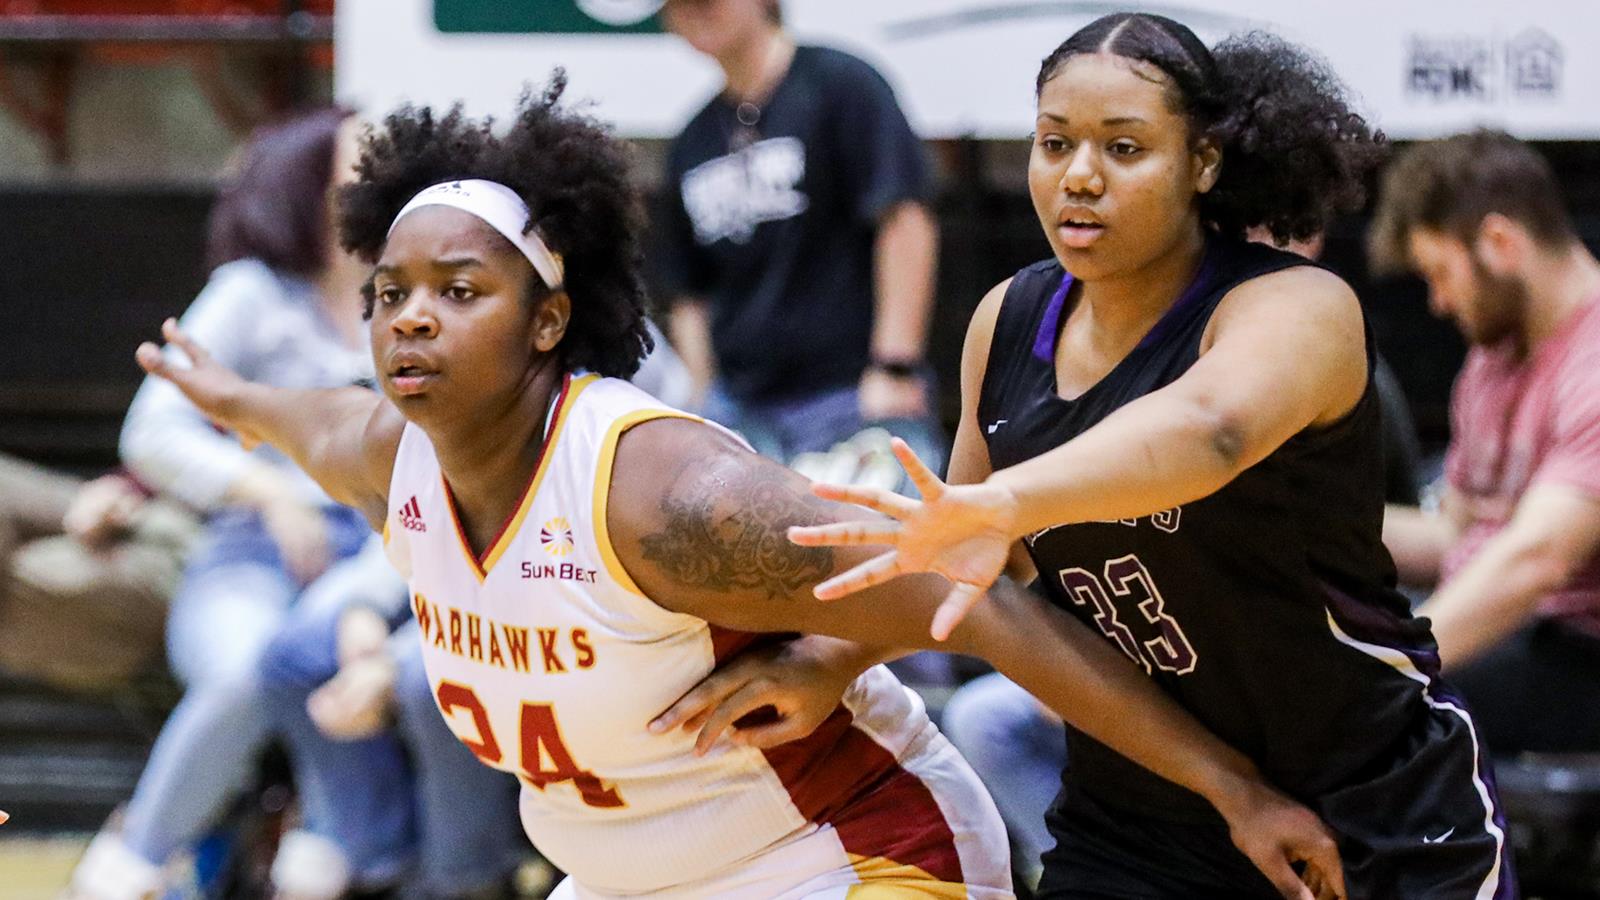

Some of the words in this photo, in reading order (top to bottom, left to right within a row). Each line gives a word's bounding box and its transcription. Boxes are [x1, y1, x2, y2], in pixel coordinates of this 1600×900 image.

[414, 592, 596, 674] WARHAWKS
[1059, 554, 1198, 675] 33
[436, 679, 628, 808] 24
